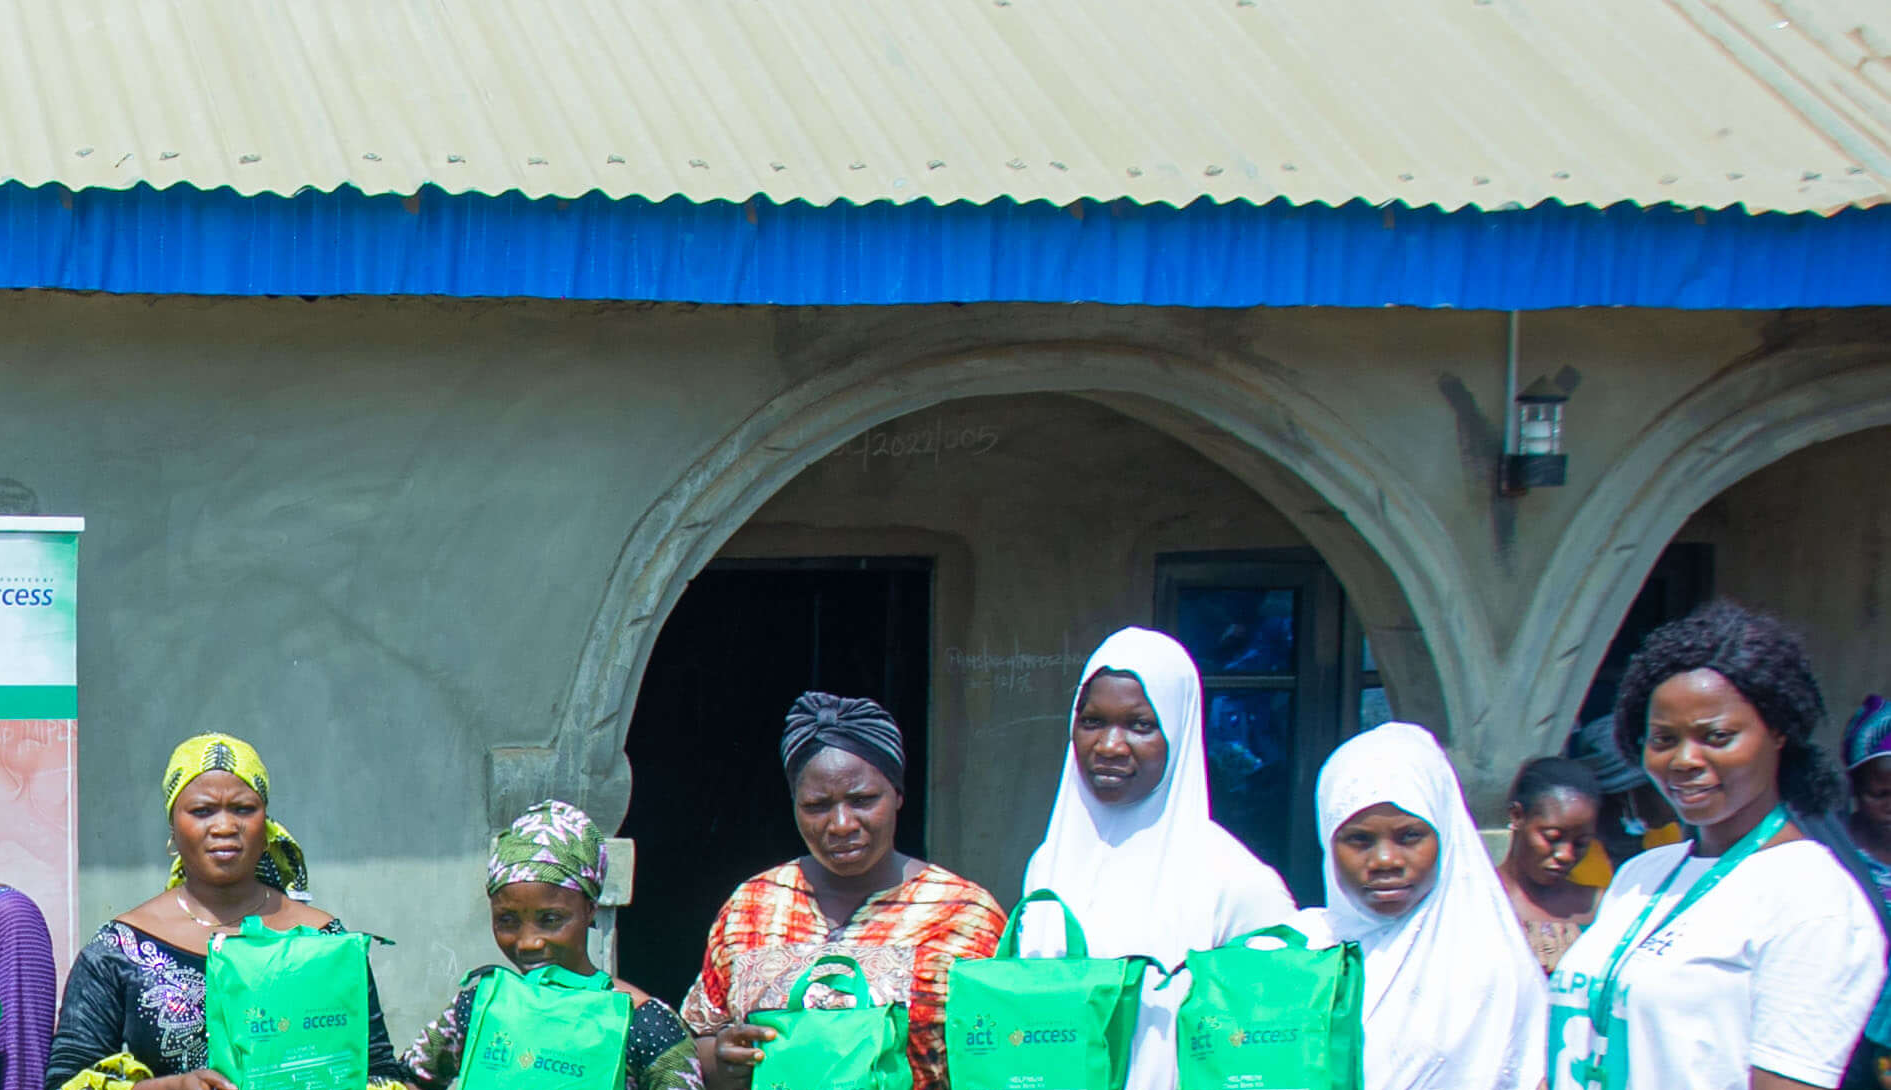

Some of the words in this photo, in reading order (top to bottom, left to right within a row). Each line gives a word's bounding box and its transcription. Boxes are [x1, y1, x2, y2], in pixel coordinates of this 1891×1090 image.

[250, 1017, 277, 1034] act
[302, 1012, 348, 1030] access
[966, 1029, 994, 1045] act
[1022, 1028, 1077, 1044] access
[483, 1046, 507, 1063] act
[533, 1053, 587, 1078] access
